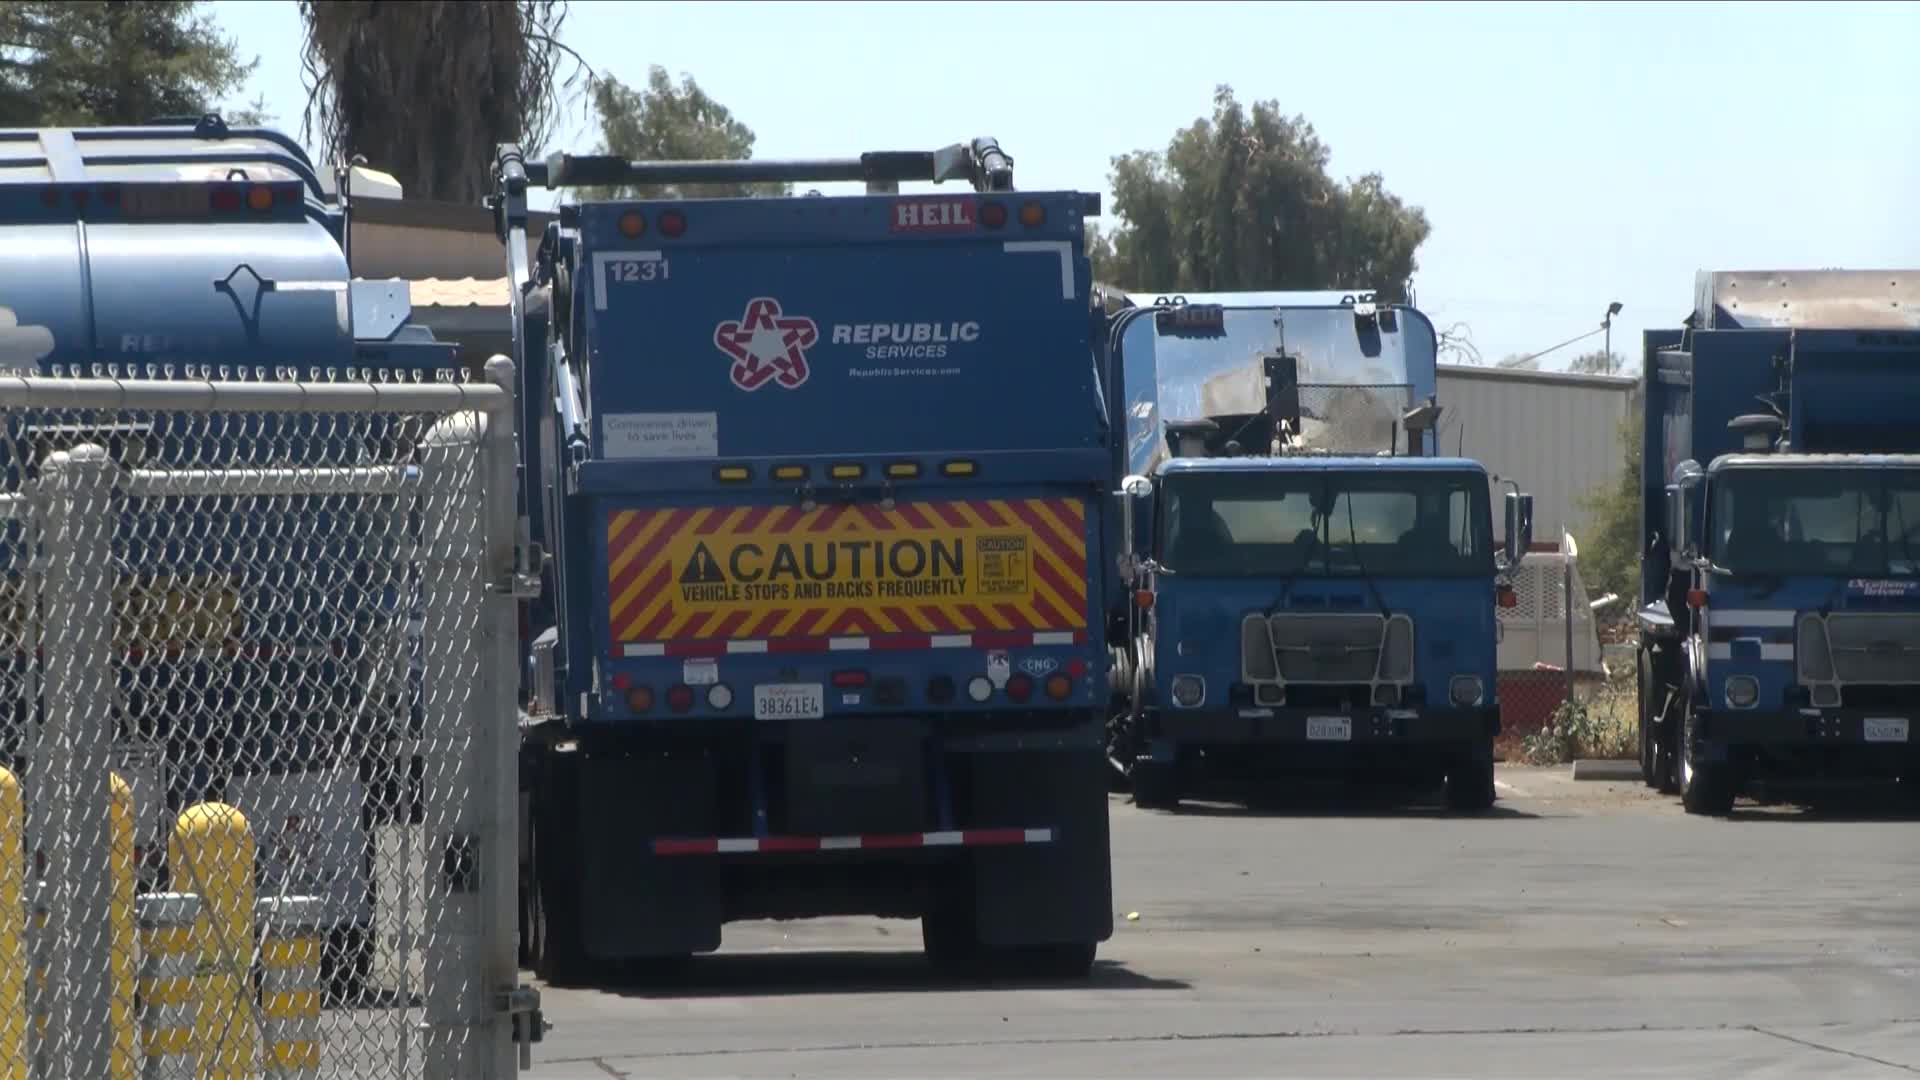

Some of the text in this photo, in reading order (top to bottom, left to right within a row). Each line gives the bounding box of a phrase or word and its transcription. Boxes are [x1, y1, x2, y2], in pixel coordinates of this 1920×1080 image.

[897, 203, 970, 225] HEIL
[611, 259, 669, 281] 1231
[832, 321, 980, 344] REPUBLIC
[865, 344, 947, 359] SERVICES
[849, 367, 961, 377] RepublicServices.com
[643, 432, 669, 441] save
[672, 430, 697, 441] lives
[729, 538, 964, 582] CAUTION
[682, 584, 740, 602] VEHICLE
[744, 583, 789, 601] STOPS
[795, 582, 822, 599] AND
[826, 581, 873, 599] BACKS
[878, 578, 967, 598] FREQUENTLY
[760, 696, 819, 715] 38361E4
